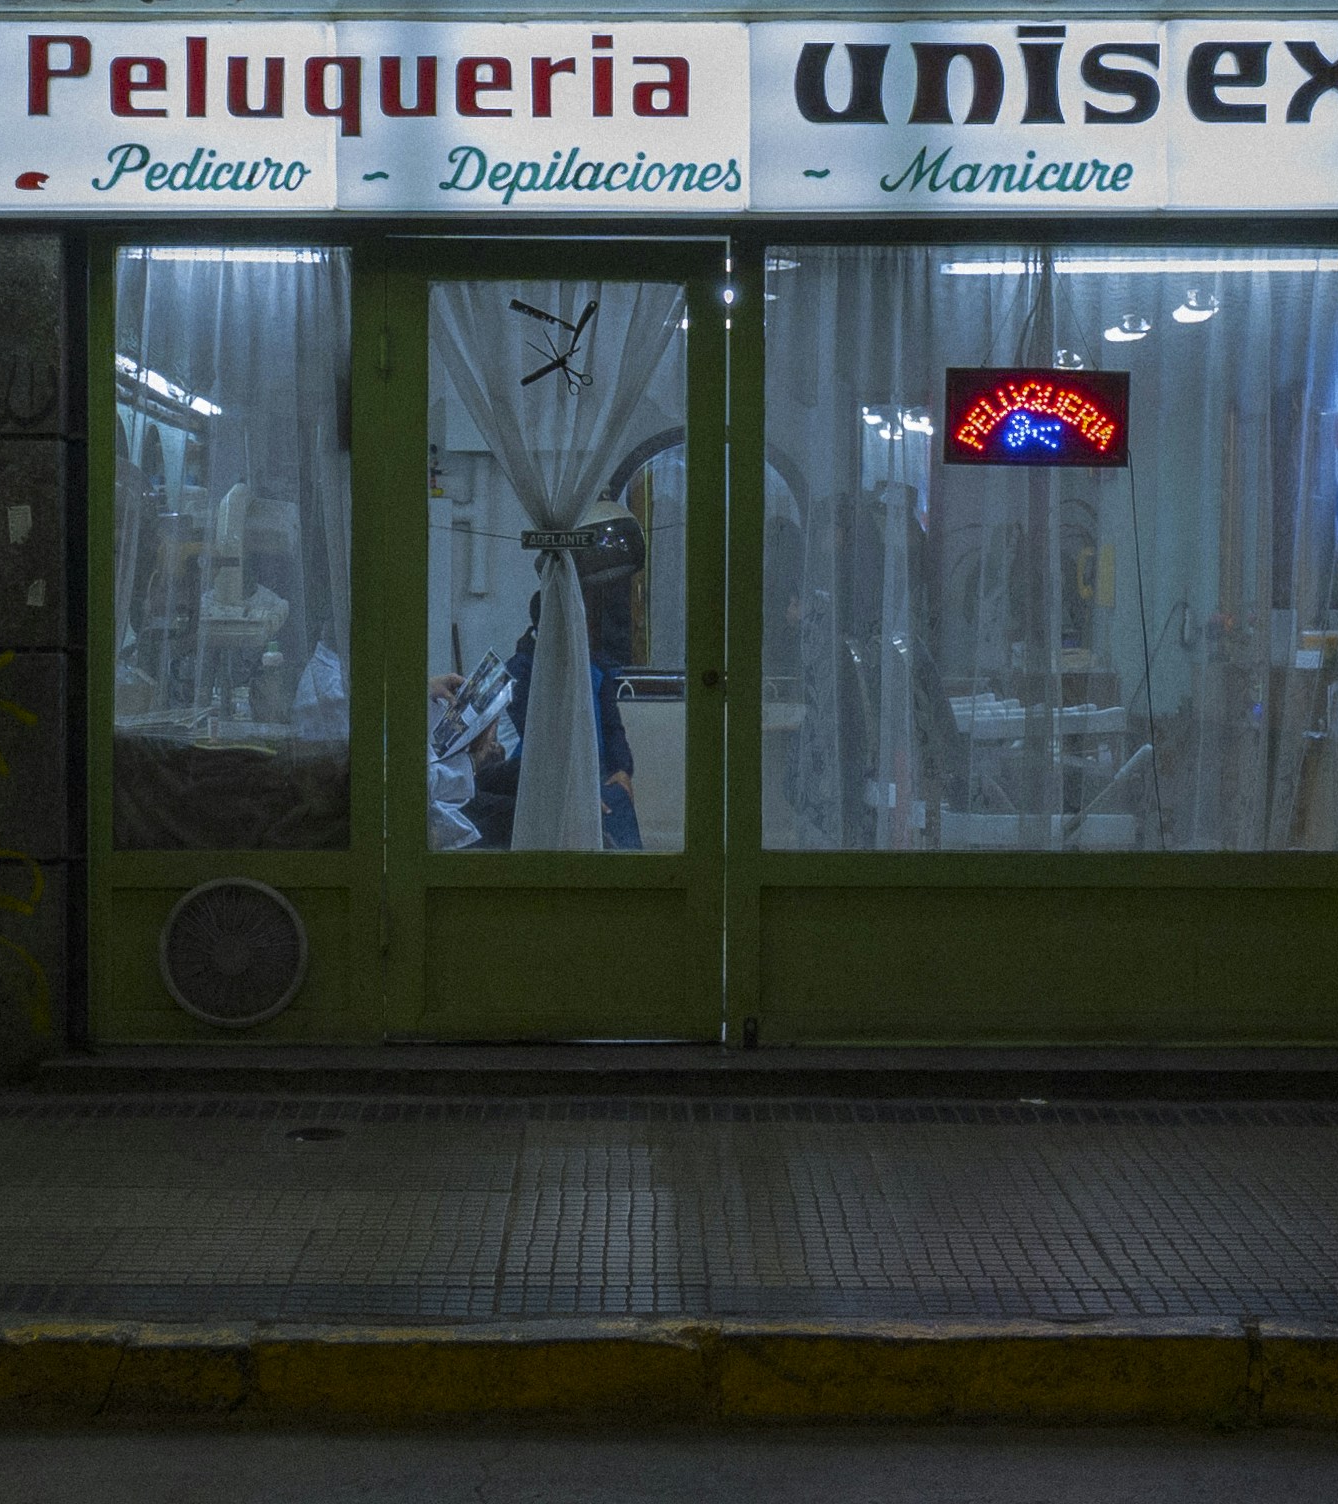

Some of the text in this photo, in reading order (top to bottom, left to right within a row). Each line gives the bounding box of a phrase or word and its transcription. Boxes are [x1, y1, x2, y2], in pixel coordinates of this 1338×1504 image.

[27, 33, 689, 137] Peluqueria
[91, 142, 311, 194] Pedicuro
[438, 145, 742, 204] Depilaciones
[880, 145, 1134, 193] Manicure
[956, 381, 1114, 451] PELUQUERIA
[529, 534, 589, 545] ADELANTE
